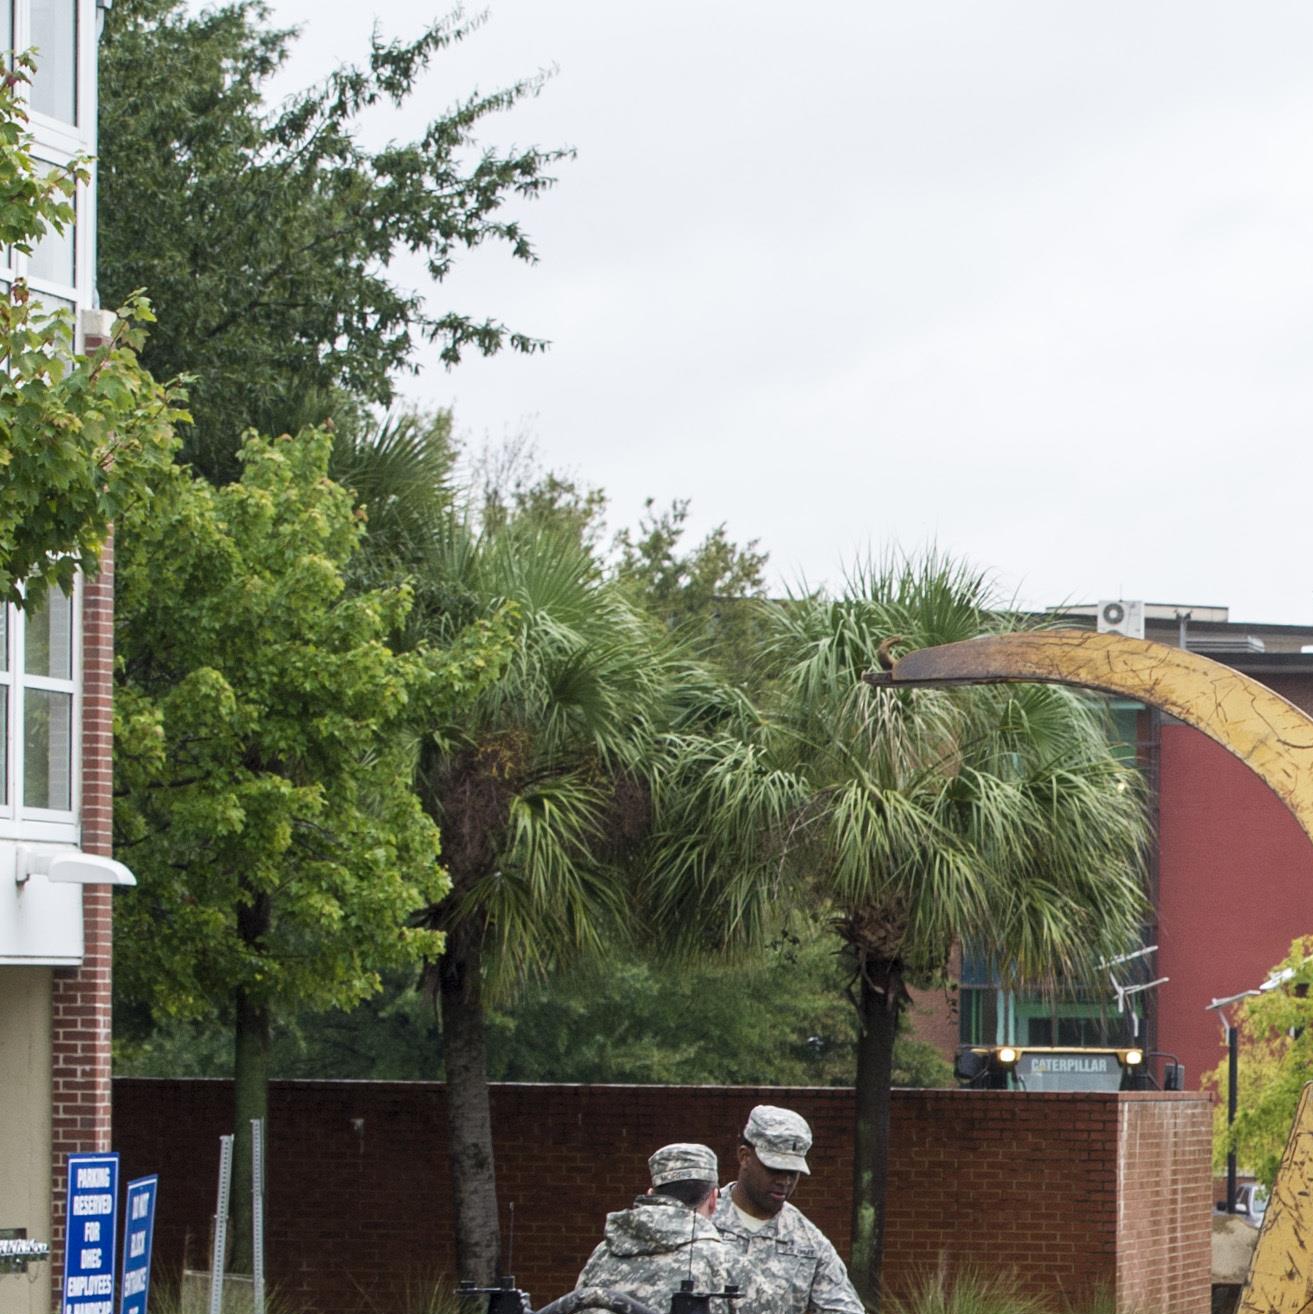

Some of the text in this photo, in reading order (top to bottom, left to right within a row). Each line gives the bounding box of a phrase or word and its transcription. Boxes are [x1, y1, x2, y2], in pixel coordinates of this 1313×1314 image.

[1031, 1057, 1107, 1072] CATERPILLAR
[77, 1167, 111, 1189] PARKING
[73, 1194, 112, 1216] RESERVED
[84, 1221, 101, 1243] FOR
[67, 1274, 112, 1297] EMPLOYEES
